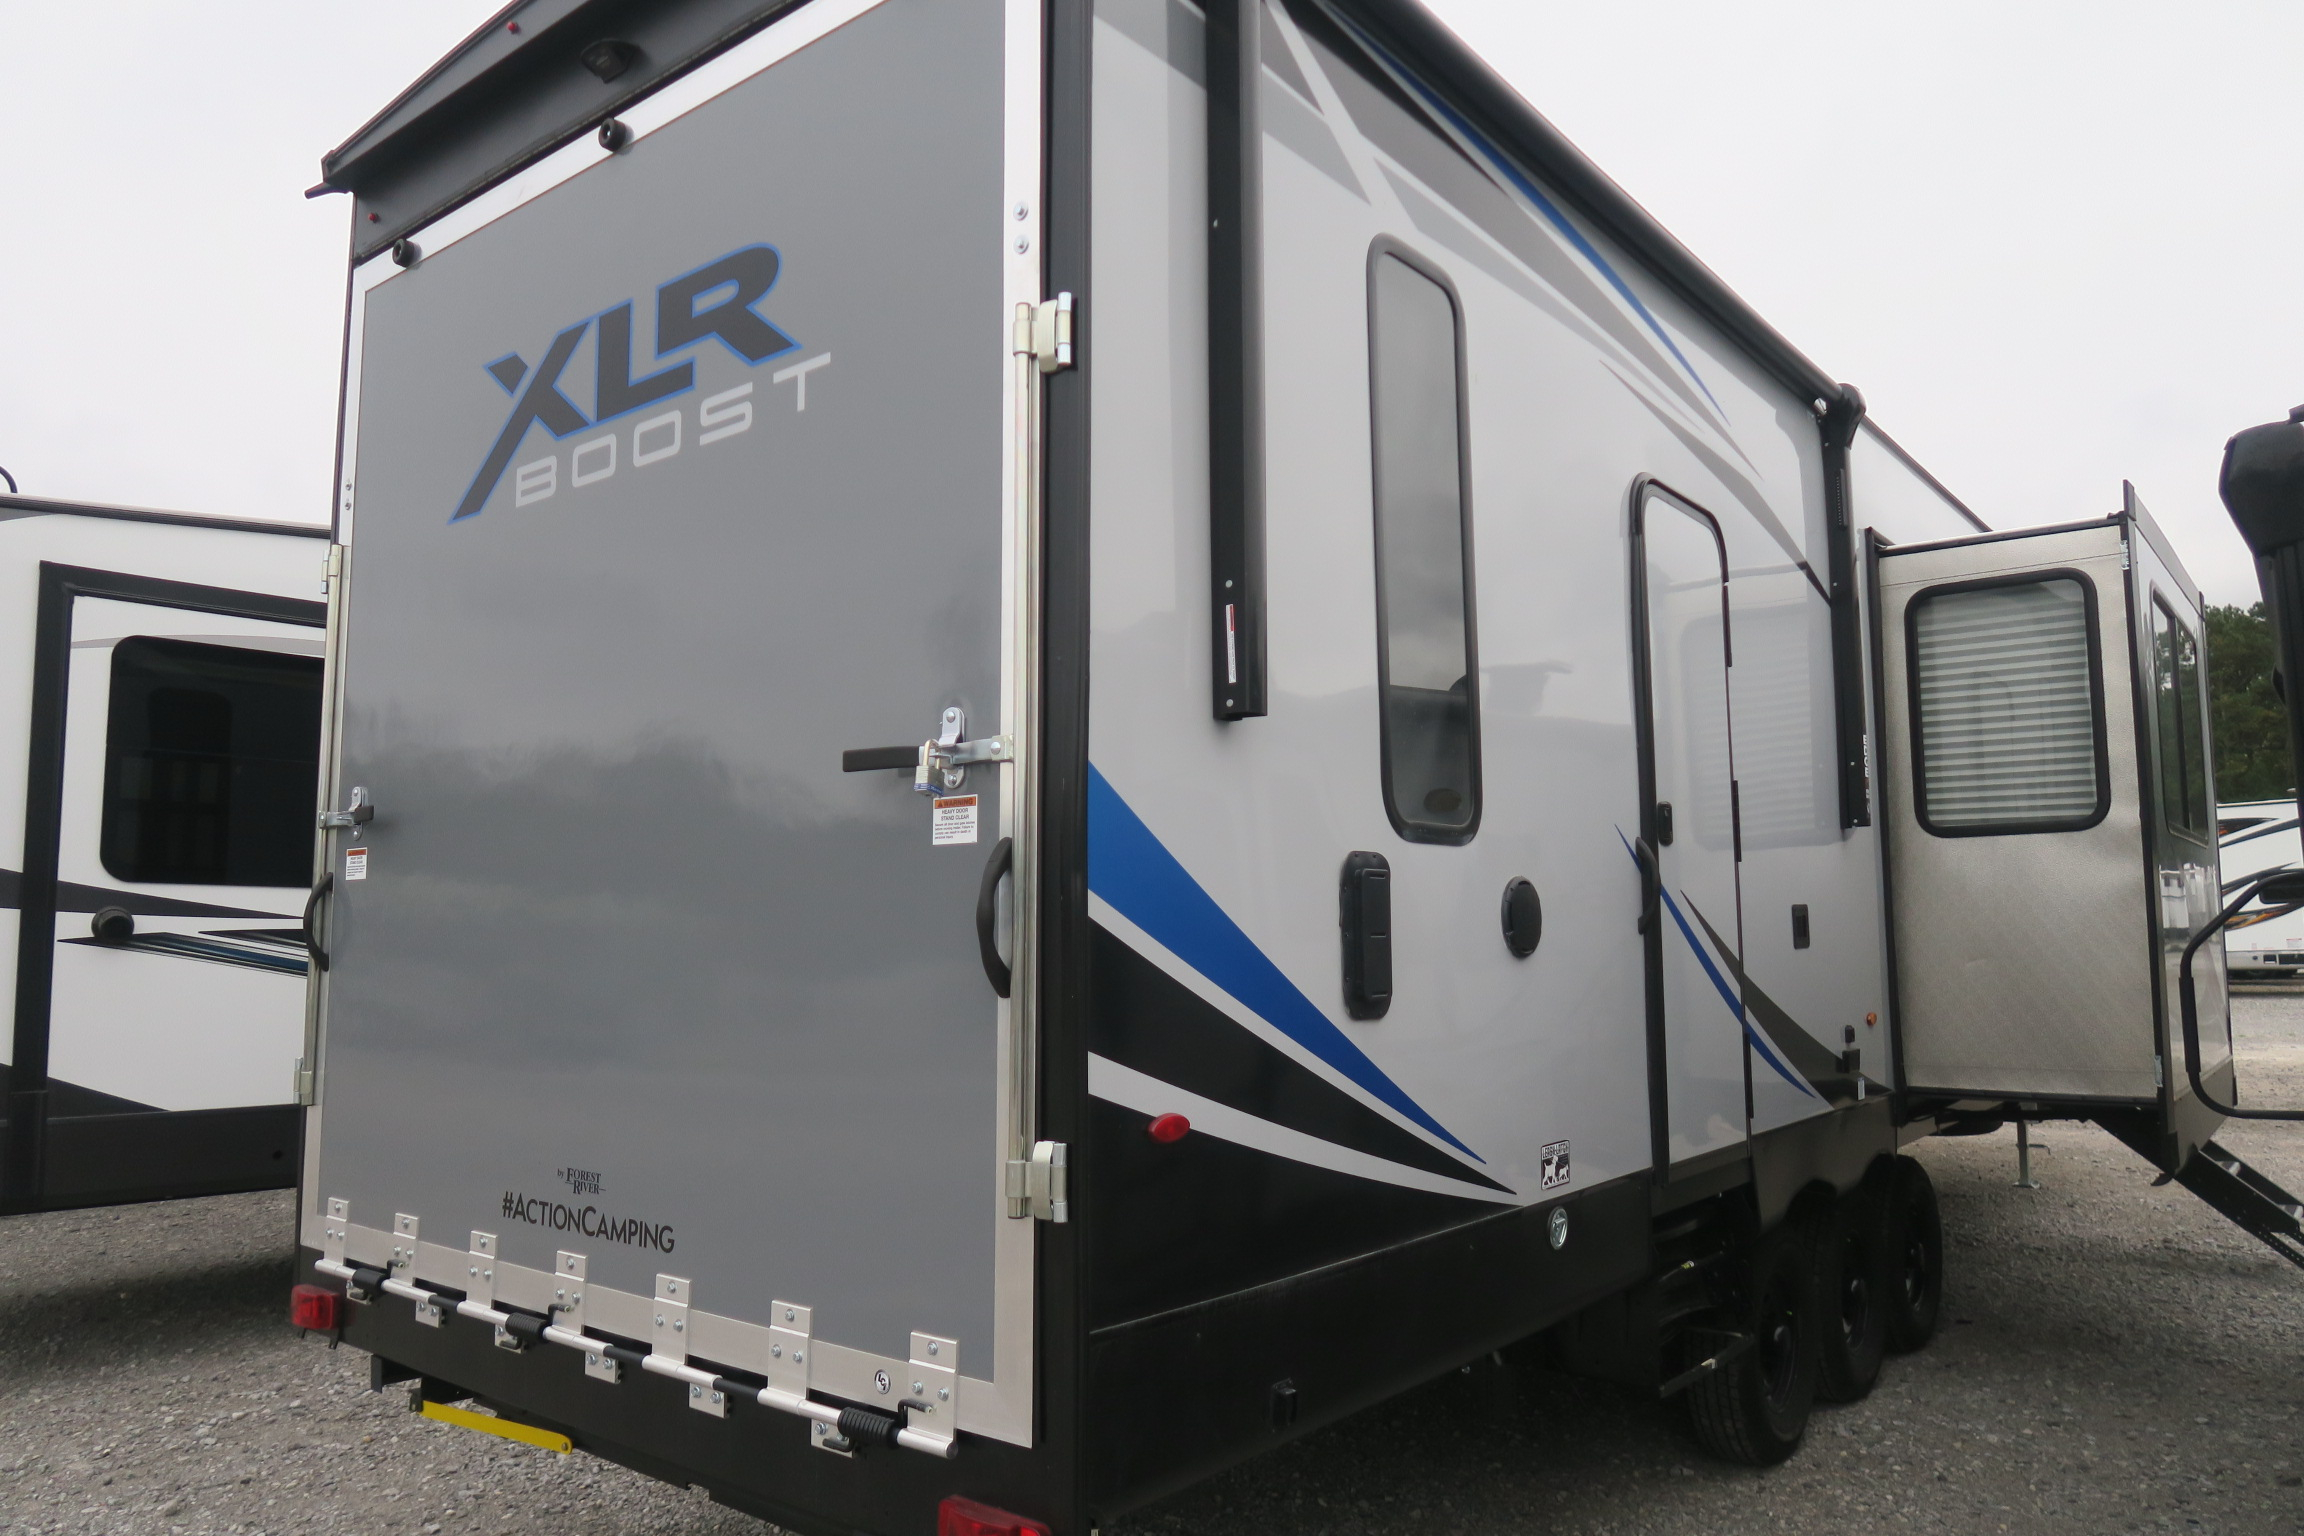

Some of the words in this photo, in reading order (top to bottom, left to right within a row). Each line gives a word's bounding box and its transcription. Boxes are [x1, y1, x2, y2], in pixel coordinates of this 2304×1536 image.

[447, 242, 803, 525] XLR
[515, 351, 831, 508] BOOST
[944, 798, 973, 807] WARNING
[557, 1168, 564, 1179] by
